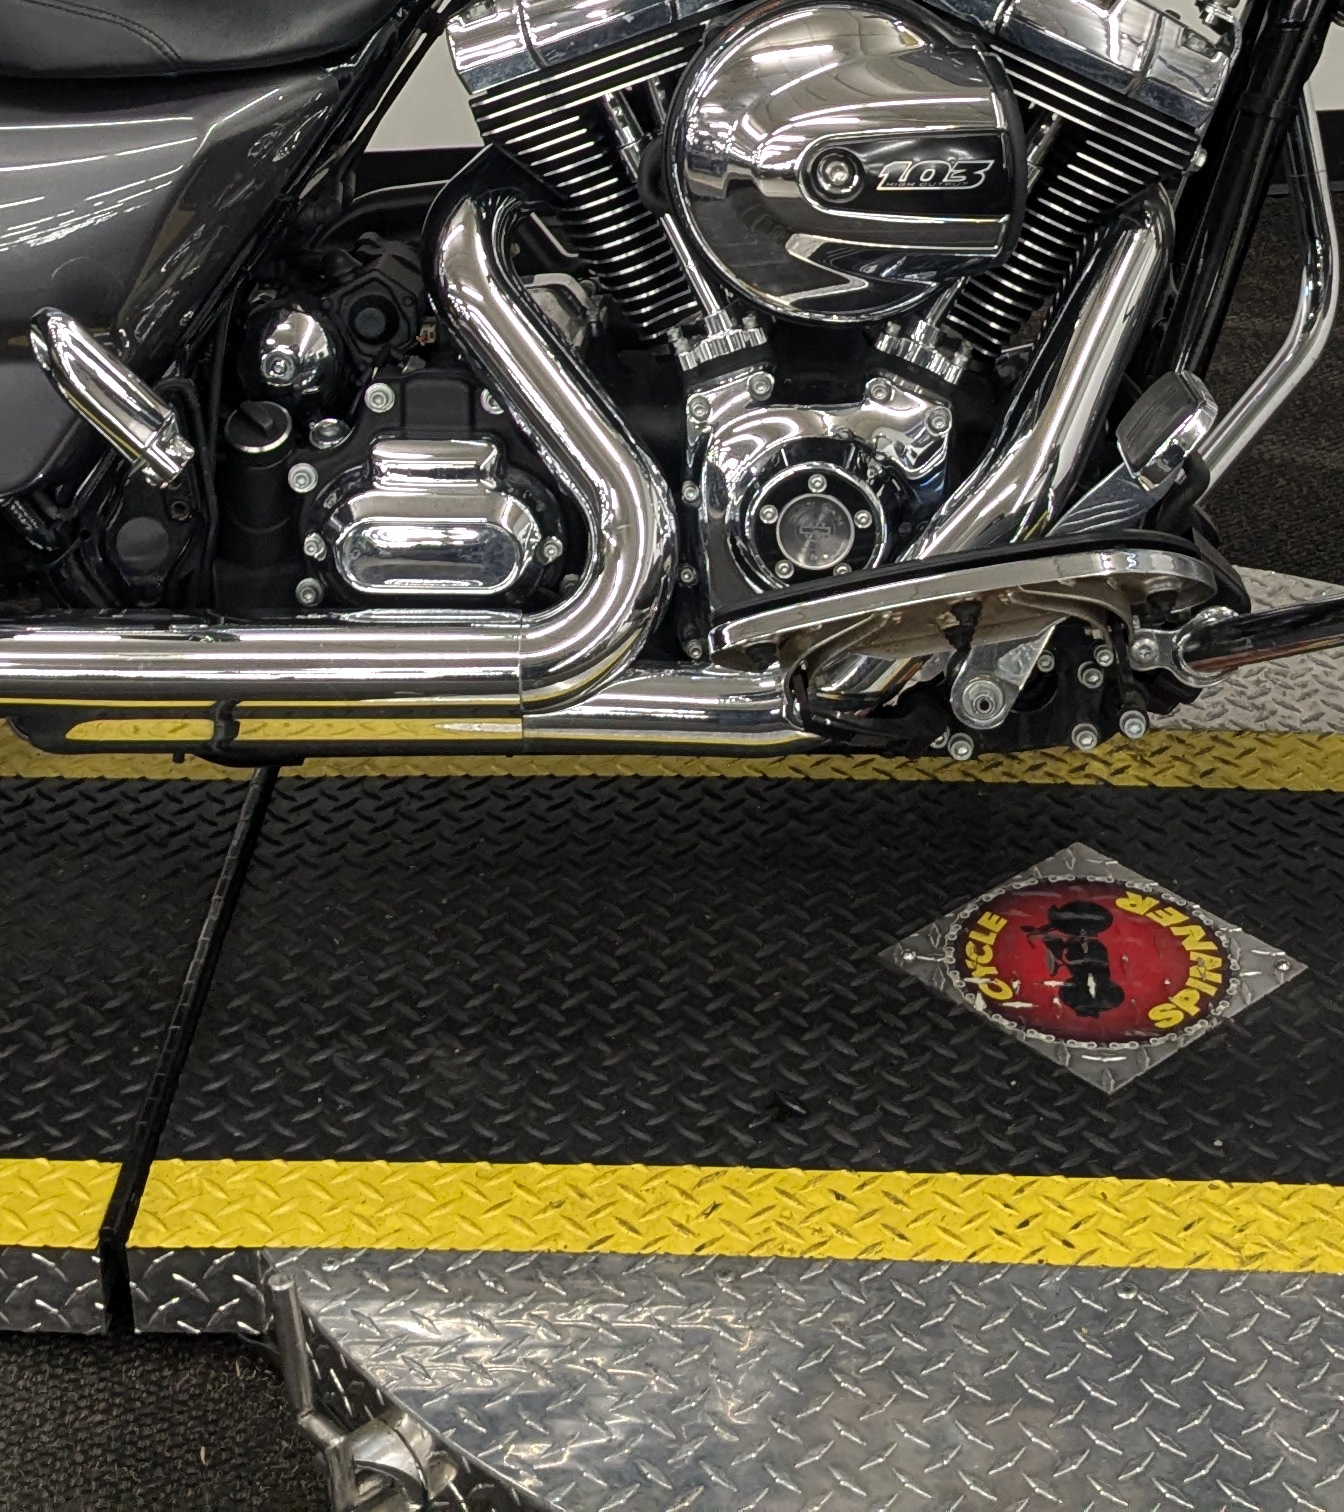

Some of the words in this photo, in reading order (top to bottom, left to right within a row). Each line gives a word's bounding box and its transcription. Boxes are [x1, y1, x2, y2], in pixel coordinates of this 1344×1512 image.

[876, 159, 995, 190] 103
[964, 910, 1009, 1003] CYCLE
[1114, 890, 1224, 1030] SPINNER
